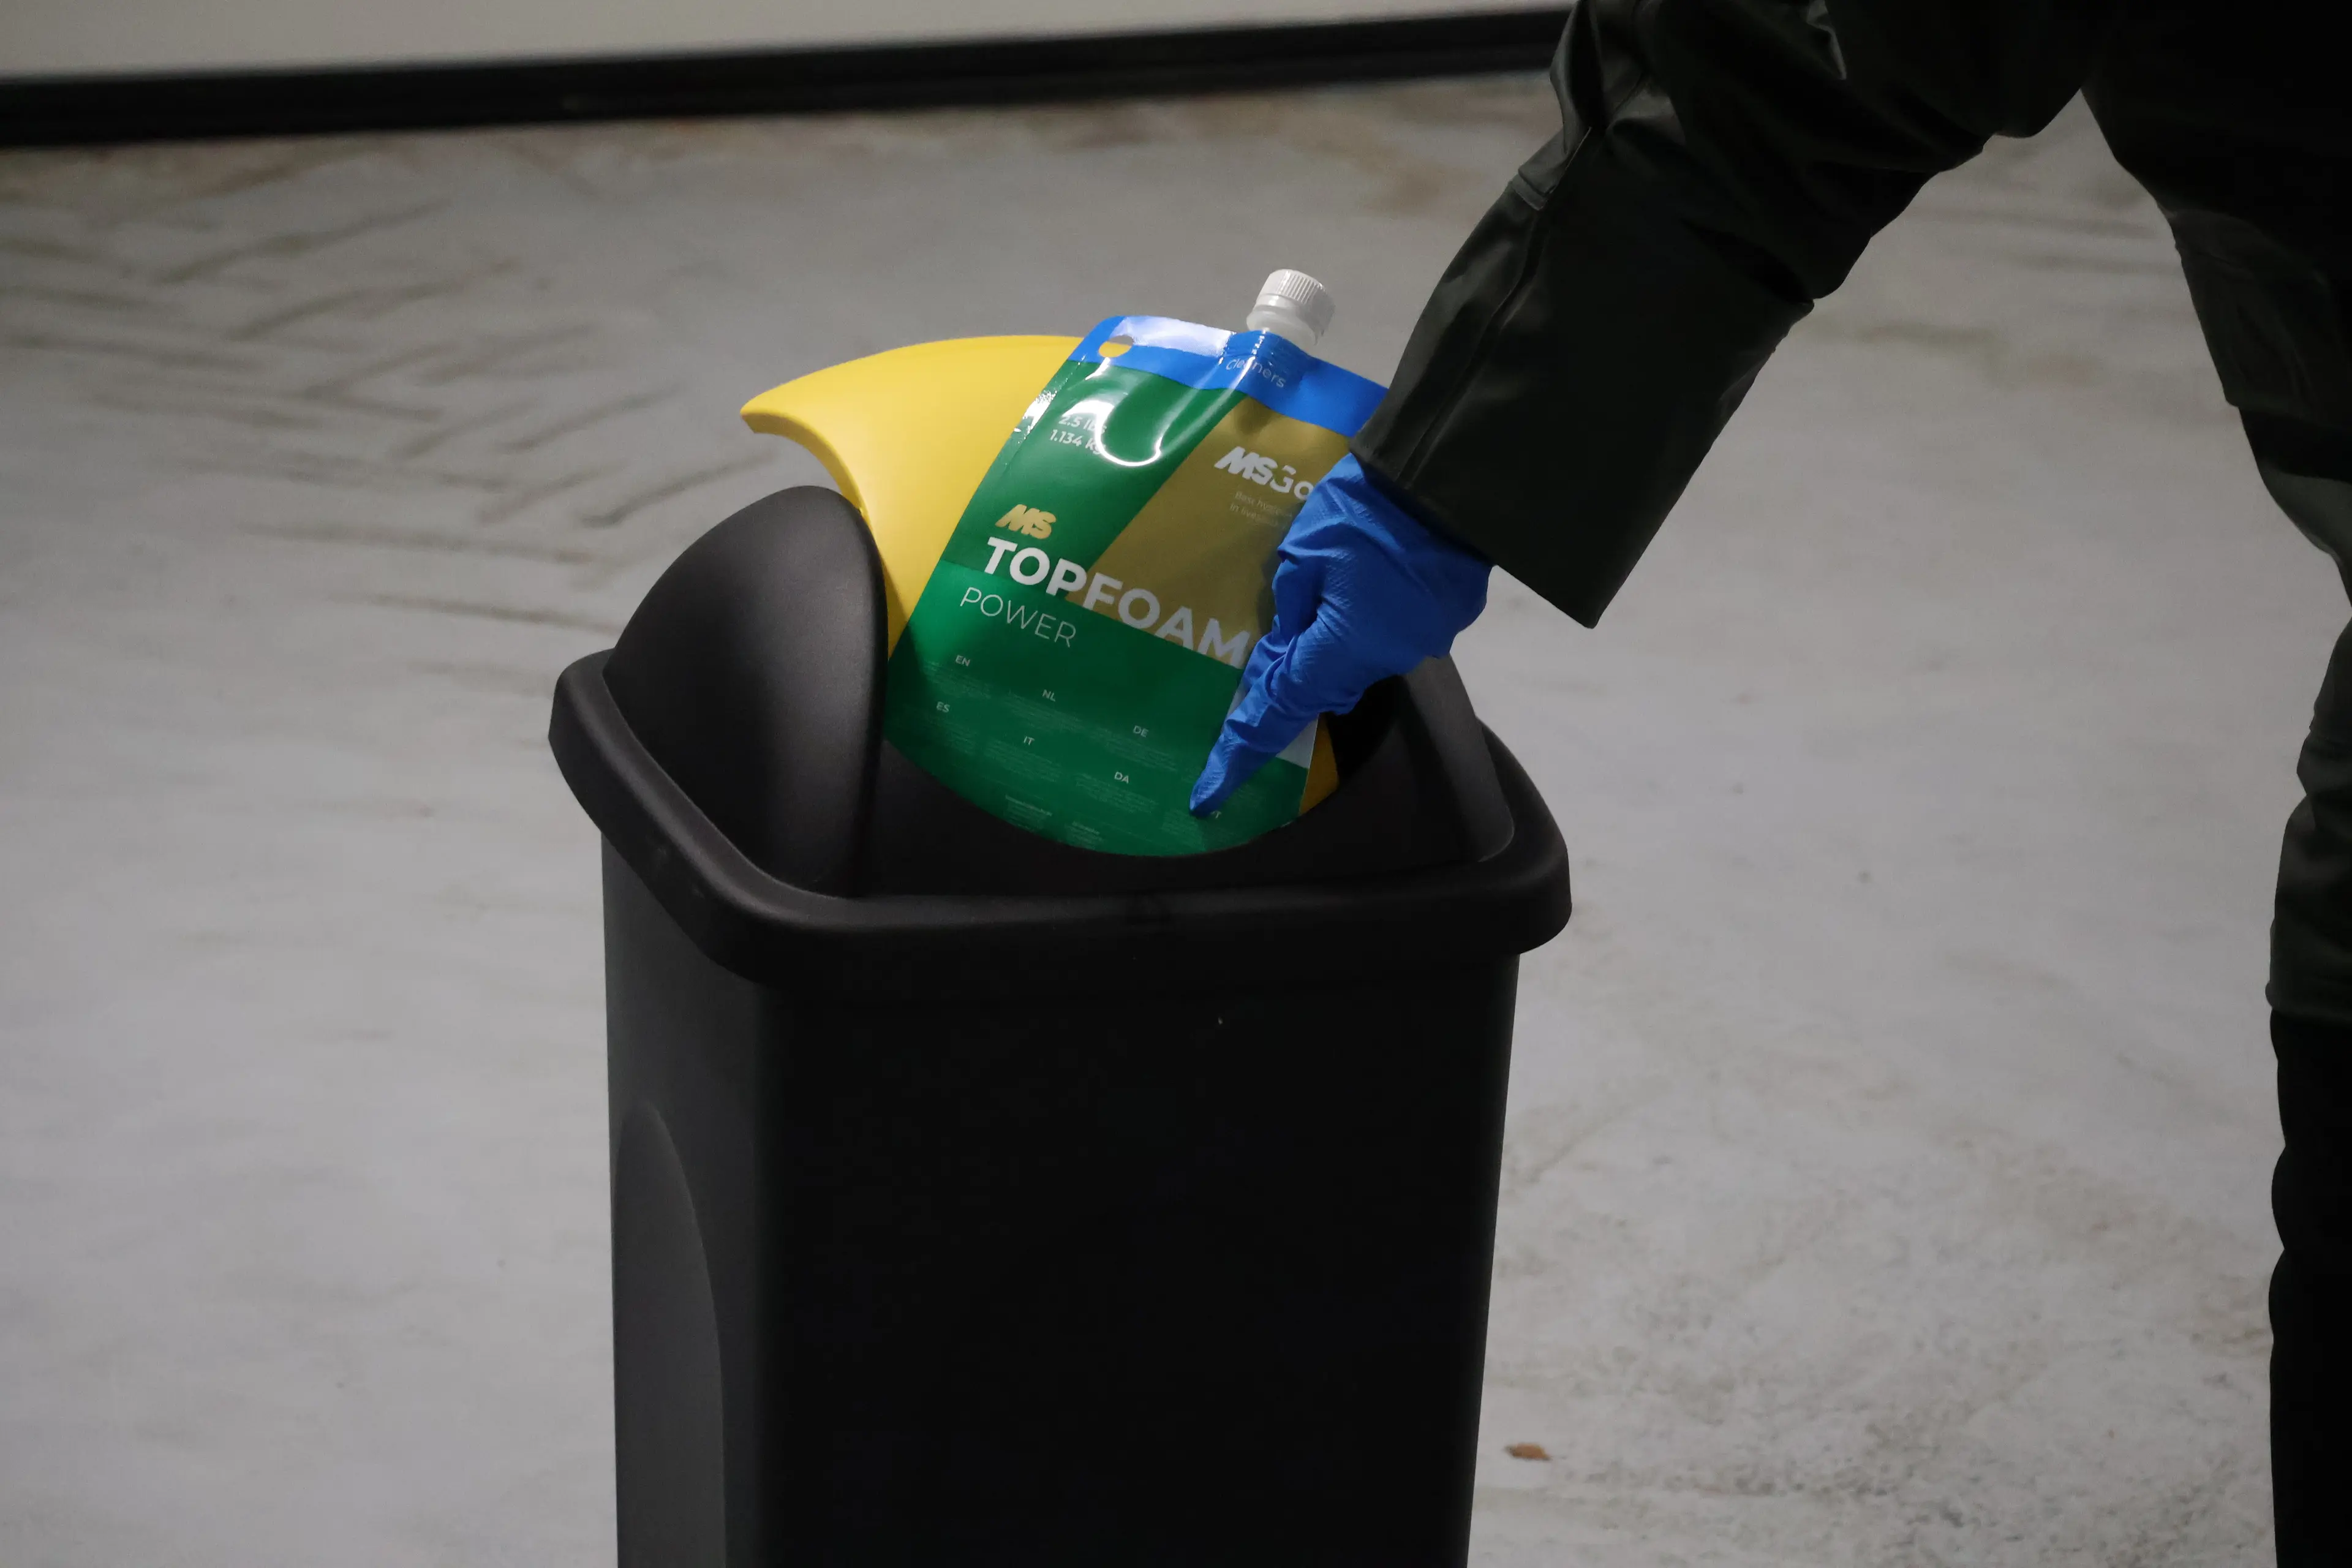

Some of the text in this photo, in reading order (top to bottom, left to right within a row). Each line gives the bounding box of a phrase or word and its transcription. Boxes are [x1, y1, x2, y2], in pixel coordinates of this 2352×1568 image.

[1226, 358, 1286, 388] cleners
[1058, 415, 1083, 428] 2.5
[1049, 429, 1084, 447] 1.134
[995, 503, 1057, 540] MS
[984, 537, 1251, 669] TOPFOAM
[960, 586, 1076, 648] POWER
[955, 654, 971, 666] EN
[1042, 689, 1056, 702] NL
[936, 701, 950, 713] ES
[1133, 725, 1149, 737] DE
[1023, 736, 1035, 745] IT
[1114, 771, 1129, 783] DA
